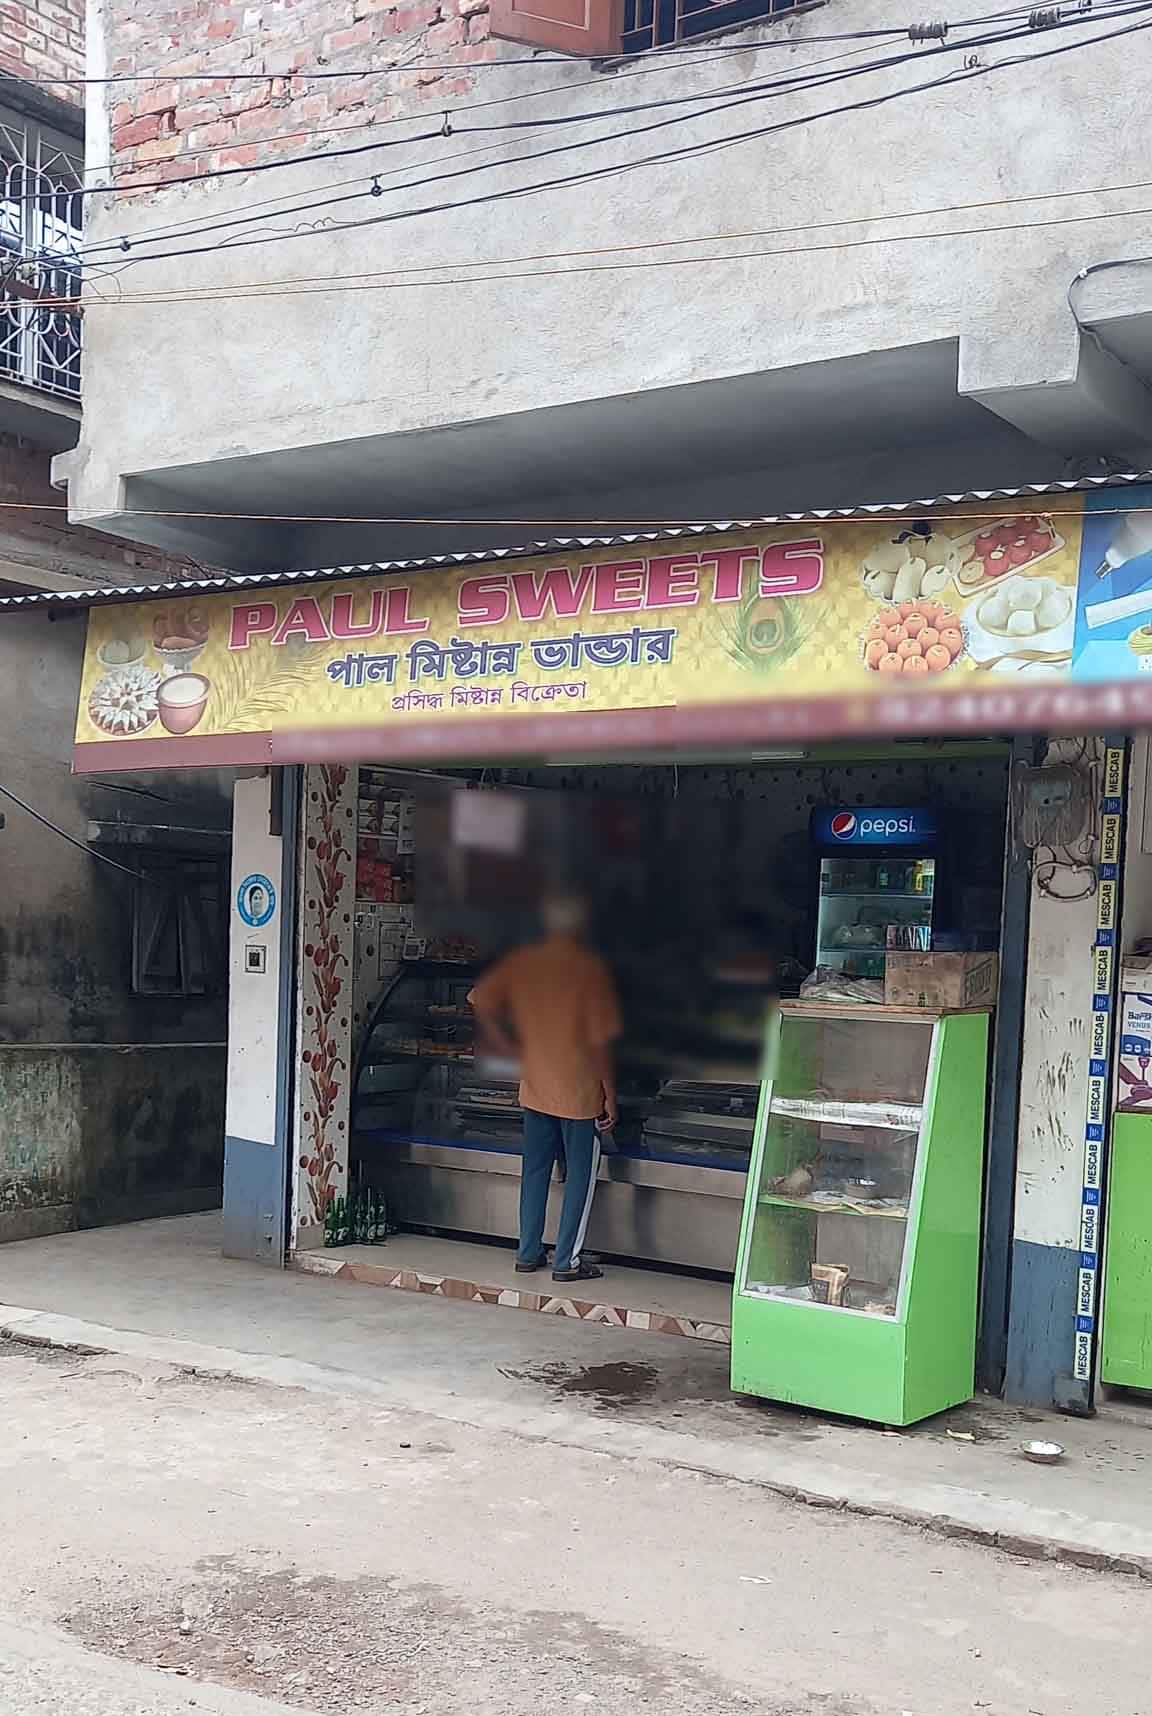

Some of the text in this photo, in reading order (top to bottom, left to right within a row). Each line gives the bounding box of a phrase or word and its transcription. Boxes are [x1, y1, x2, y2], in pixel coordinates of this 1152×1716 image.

[228, 539, 824, 650] PAUL SWEETS
[326, 653, 398, 686] পাল
[406, 637, 522, 681] মিষ্টান্ন
[450, 686, 504, 707] মিষ্টান্ন
[511, 681, 587, 704] বিক্রেতা
[1108, 751, 1120, 793] MESCAB
[1105, 817, 1116, 860] MESCAB
[1100, 883, 1112, 926] MESCAB
[1097, 949, 1108, 991] MESCAB
[1094, 1014, 1105, 1056] MESCAB
[1090, 1079, 1101, 1120] MESCAB
[1087, 1143, 1098, 1185] MESCAB
[1085, 1208, 1095, 1249] MESCAB
[1081, 1272, 1092, 1313] MESCAB
[1077, 1335, 1088, 1376] MESCAB
